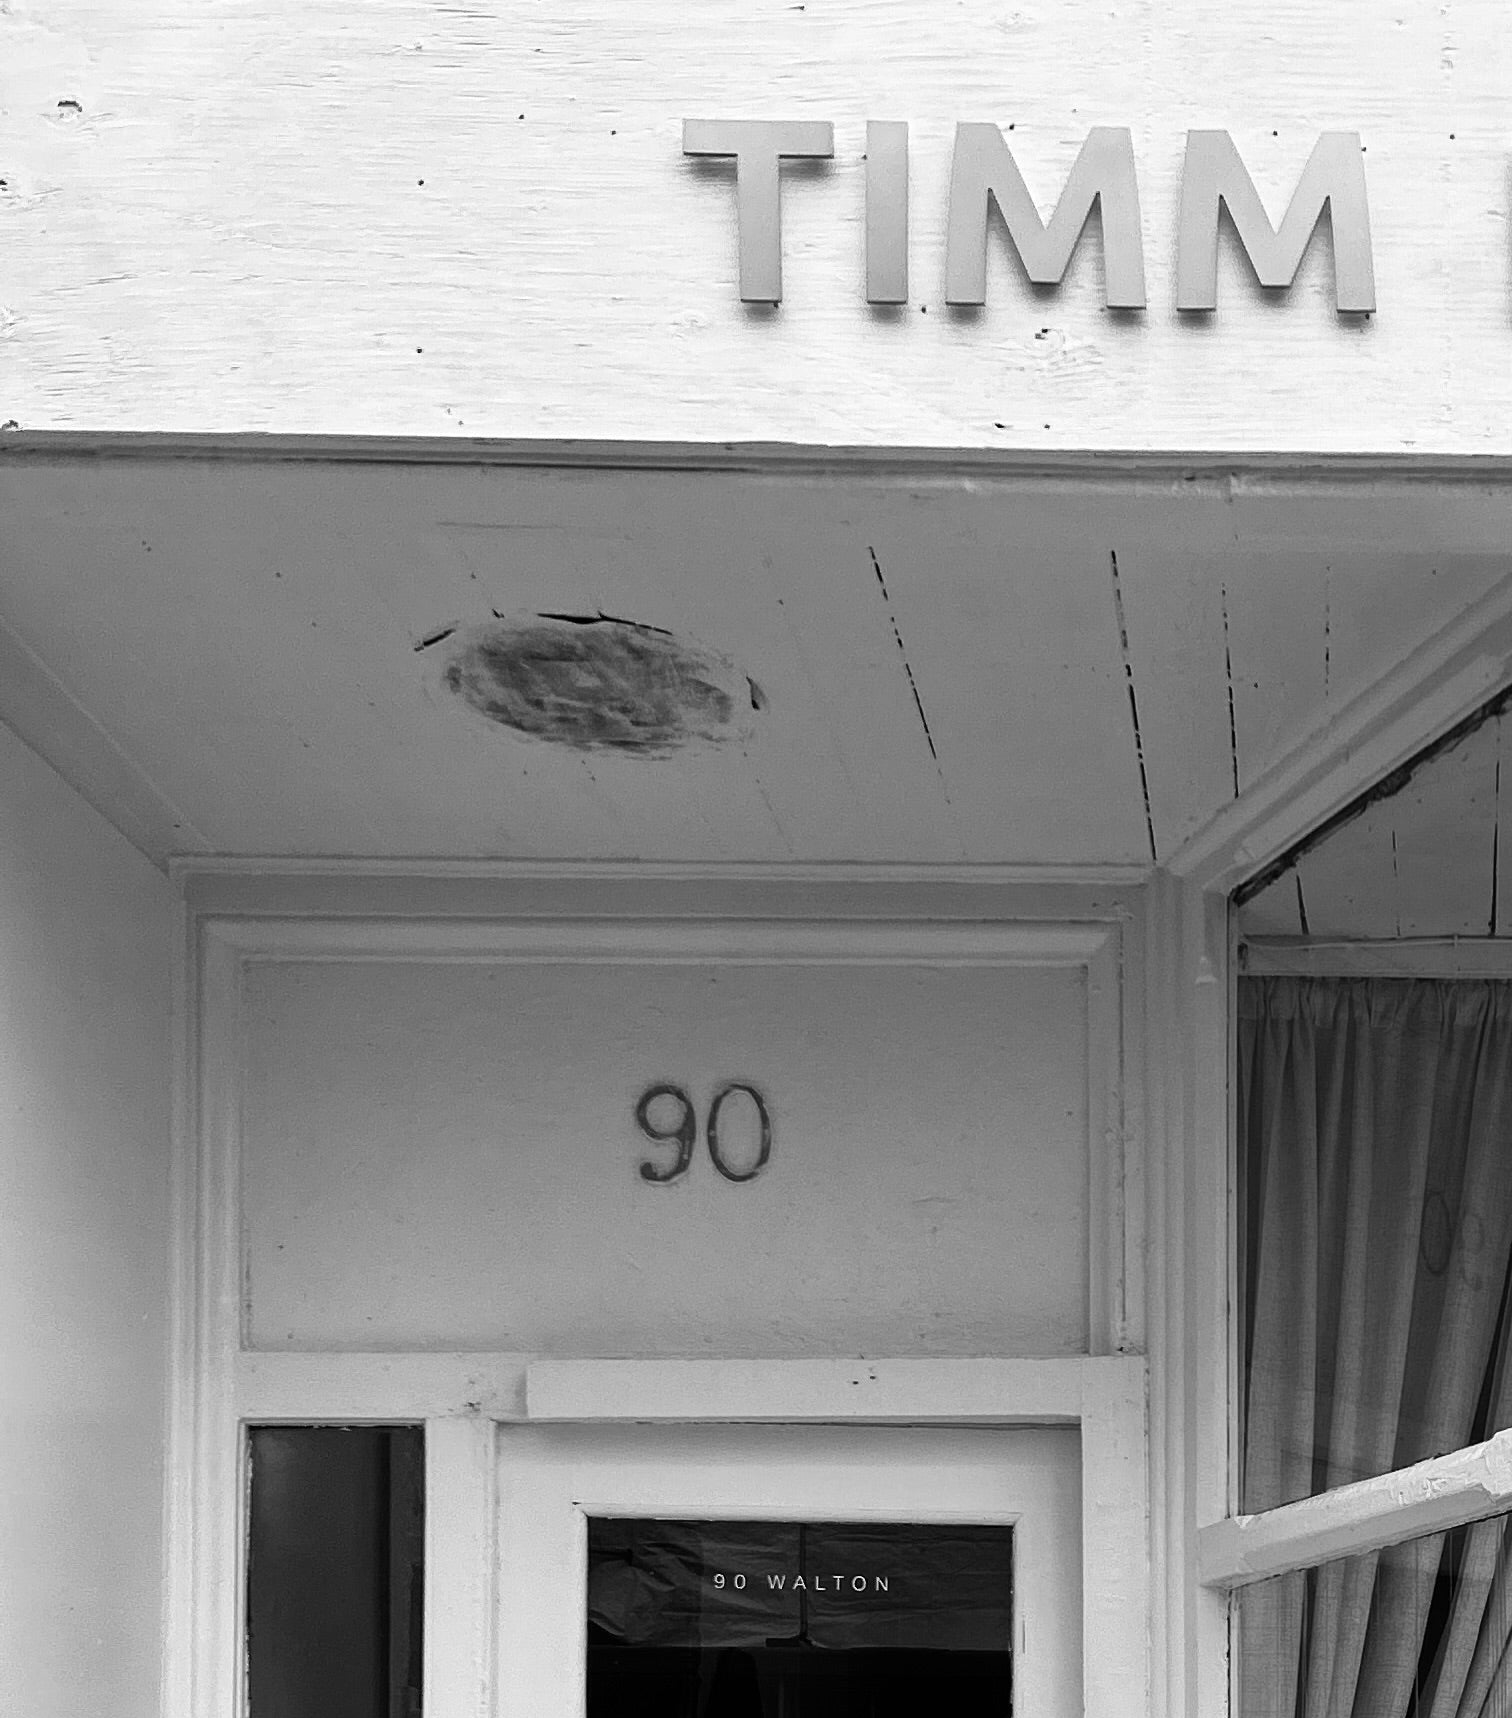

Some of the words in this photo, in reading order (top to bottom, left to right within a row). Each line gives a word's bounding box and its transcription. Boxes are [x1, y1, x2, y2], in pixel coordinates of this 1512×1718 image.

[682, 118, 1377, 313] TIMM
[636, 1083, 772, 1183] 90
[713, 1573, 747, 1590] 90
[767, 1574, 890, 1592] WALTON
